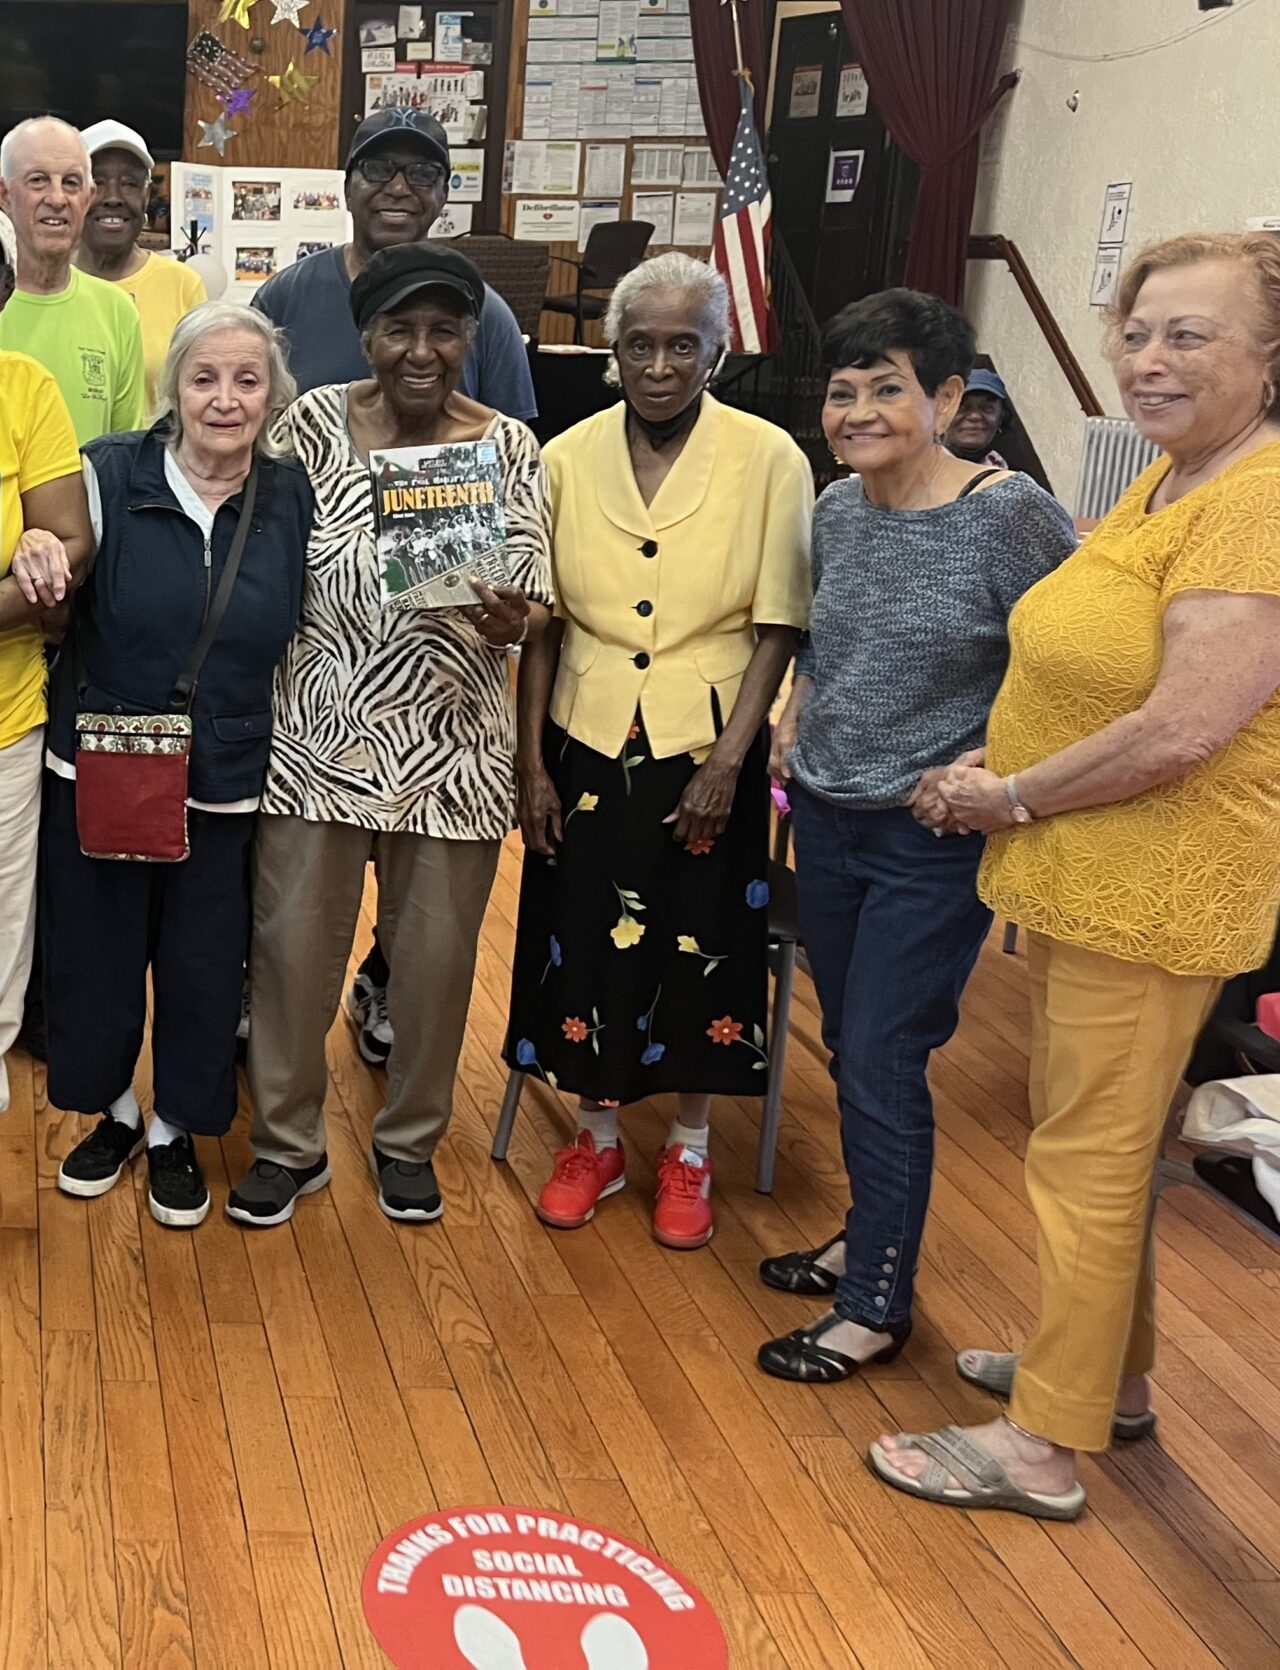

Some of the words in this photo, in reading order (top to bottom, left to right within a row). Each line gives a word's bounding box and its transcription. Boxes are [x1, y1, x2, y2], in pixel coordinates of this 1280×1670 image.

[522, 202, 576, 212] Defibrillator
[382, 480, 494, 516] JUNETEENTH
[483, 554, 510, 587] FREEDO
[377, 1522, 455, 1595] THANKS
[447, 1511, 512, 1539] FOR
[515, 1513, 697, 1612] PRACTICING
[471, 1548, 584, 1578] SOCIAL
[440, 1573, 631, 1608] DISTANCING
